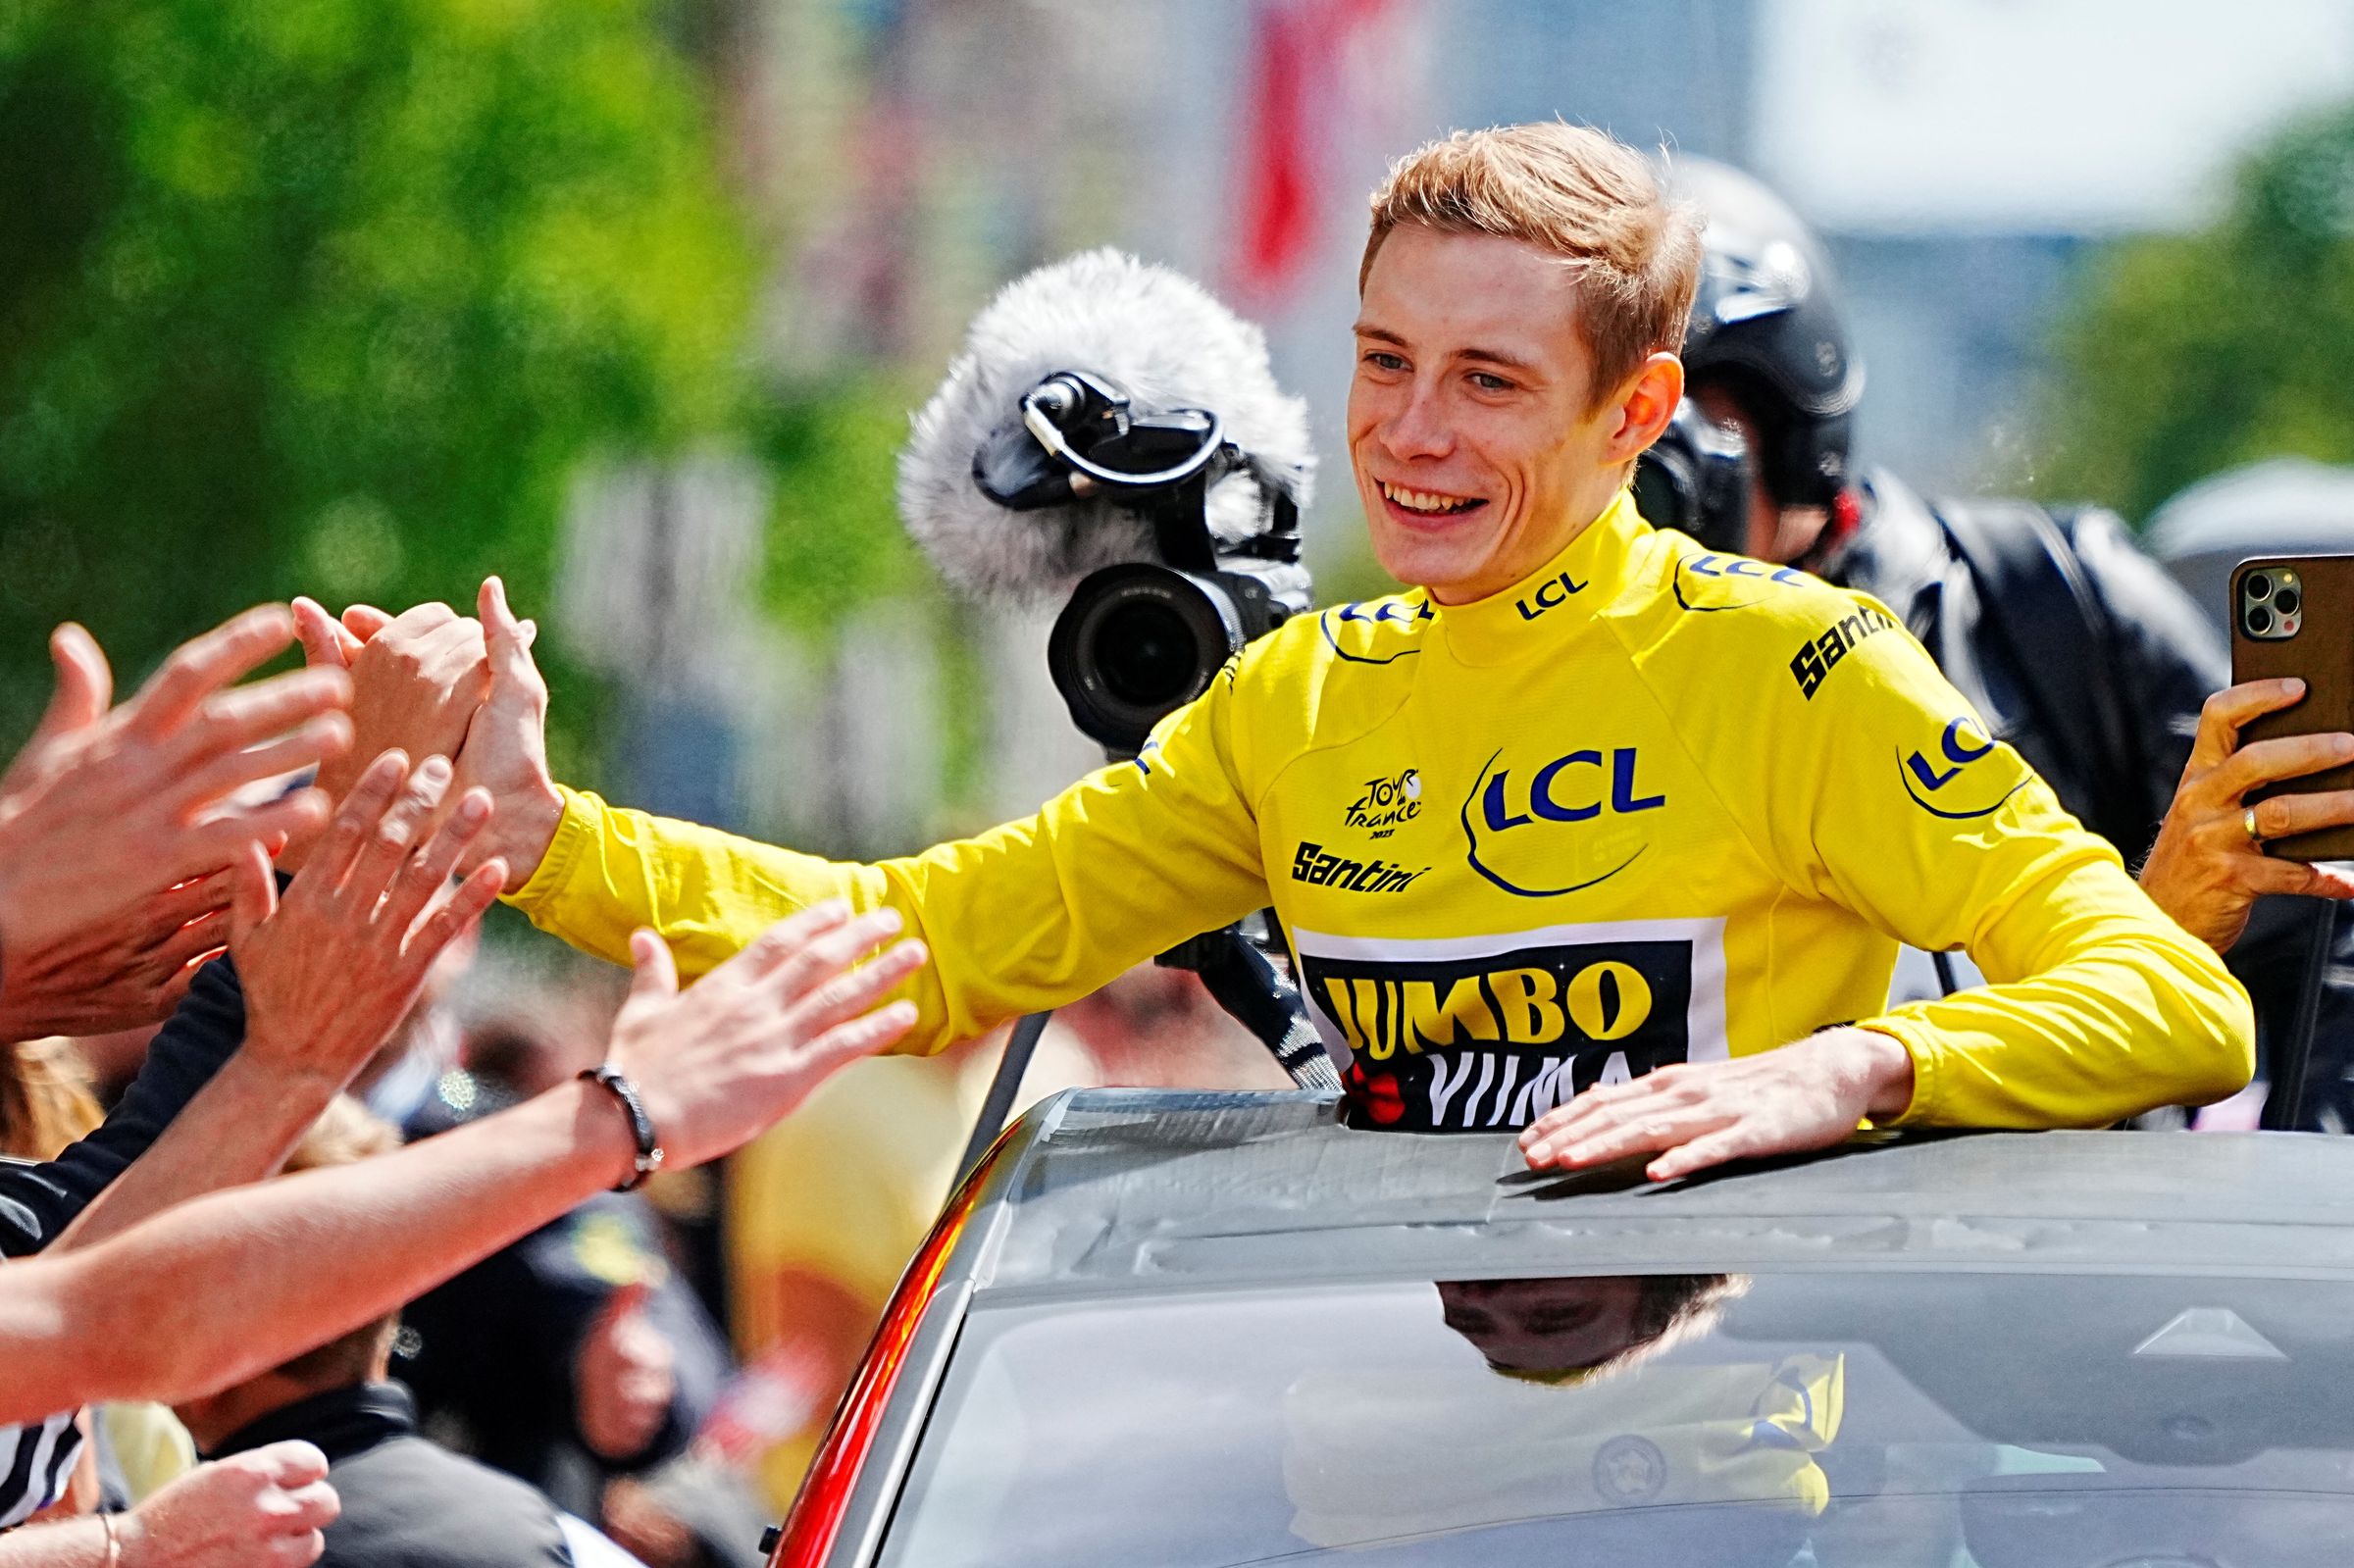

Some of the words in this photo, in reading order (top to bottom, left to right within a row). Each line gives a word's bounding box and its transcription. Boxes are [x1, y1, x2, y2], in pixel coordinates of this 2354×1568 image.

[1514, 572, 1589, 621] LCL
[1789, 605, 1894, 701] Santi
[1483, 748, 1665, 832] LCL
[1906, 717, 1996, 791] LC
[1292, 841, 1432, 892] Santini
[1323, 960, 1653, 1061] JUMBO
